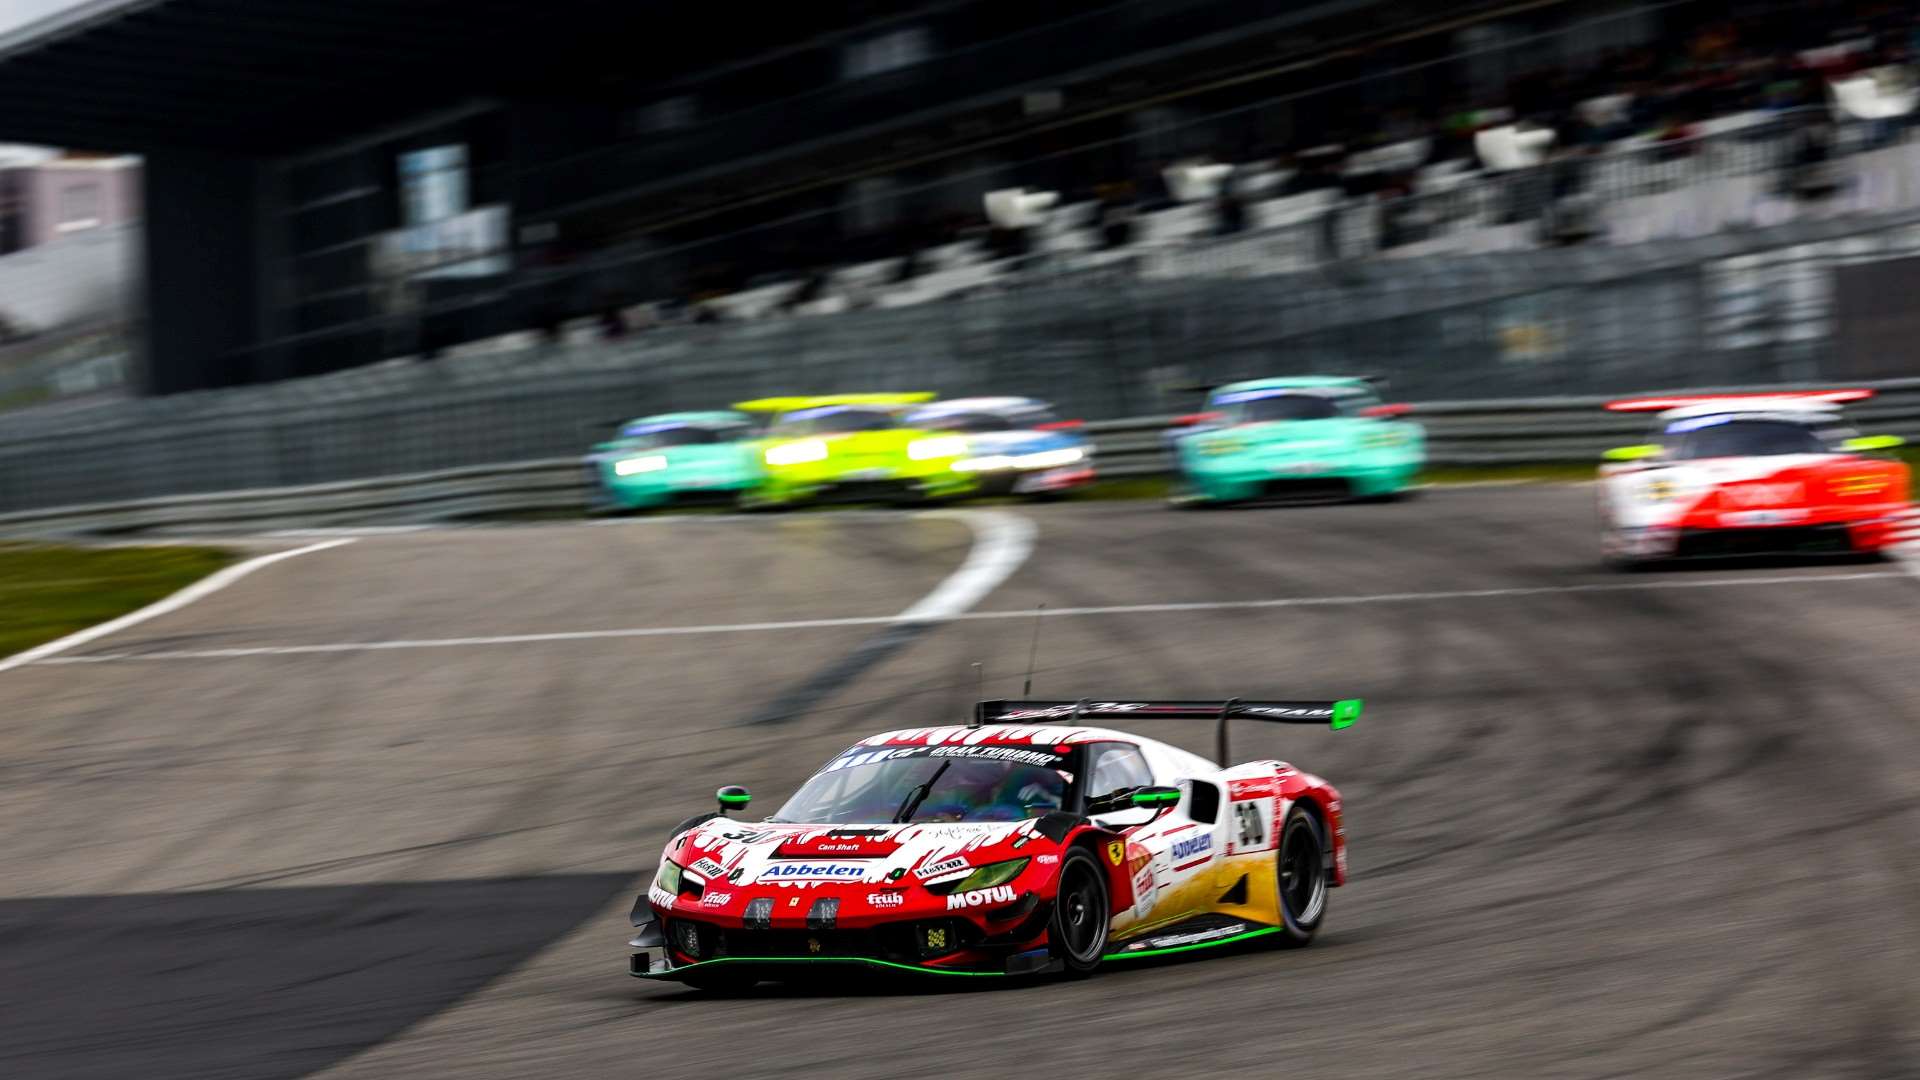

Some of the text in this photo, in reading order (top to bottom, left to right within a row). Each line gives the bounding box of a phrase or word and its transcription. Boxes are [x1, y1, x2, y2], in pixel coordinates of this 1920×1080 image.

[931, 746, 983, 756] GRAN
[836, 843, 860, 851] Shaft
[761, 864, 865, 877] Abbelen
[947, 885, 1017, 911] MOTUL
